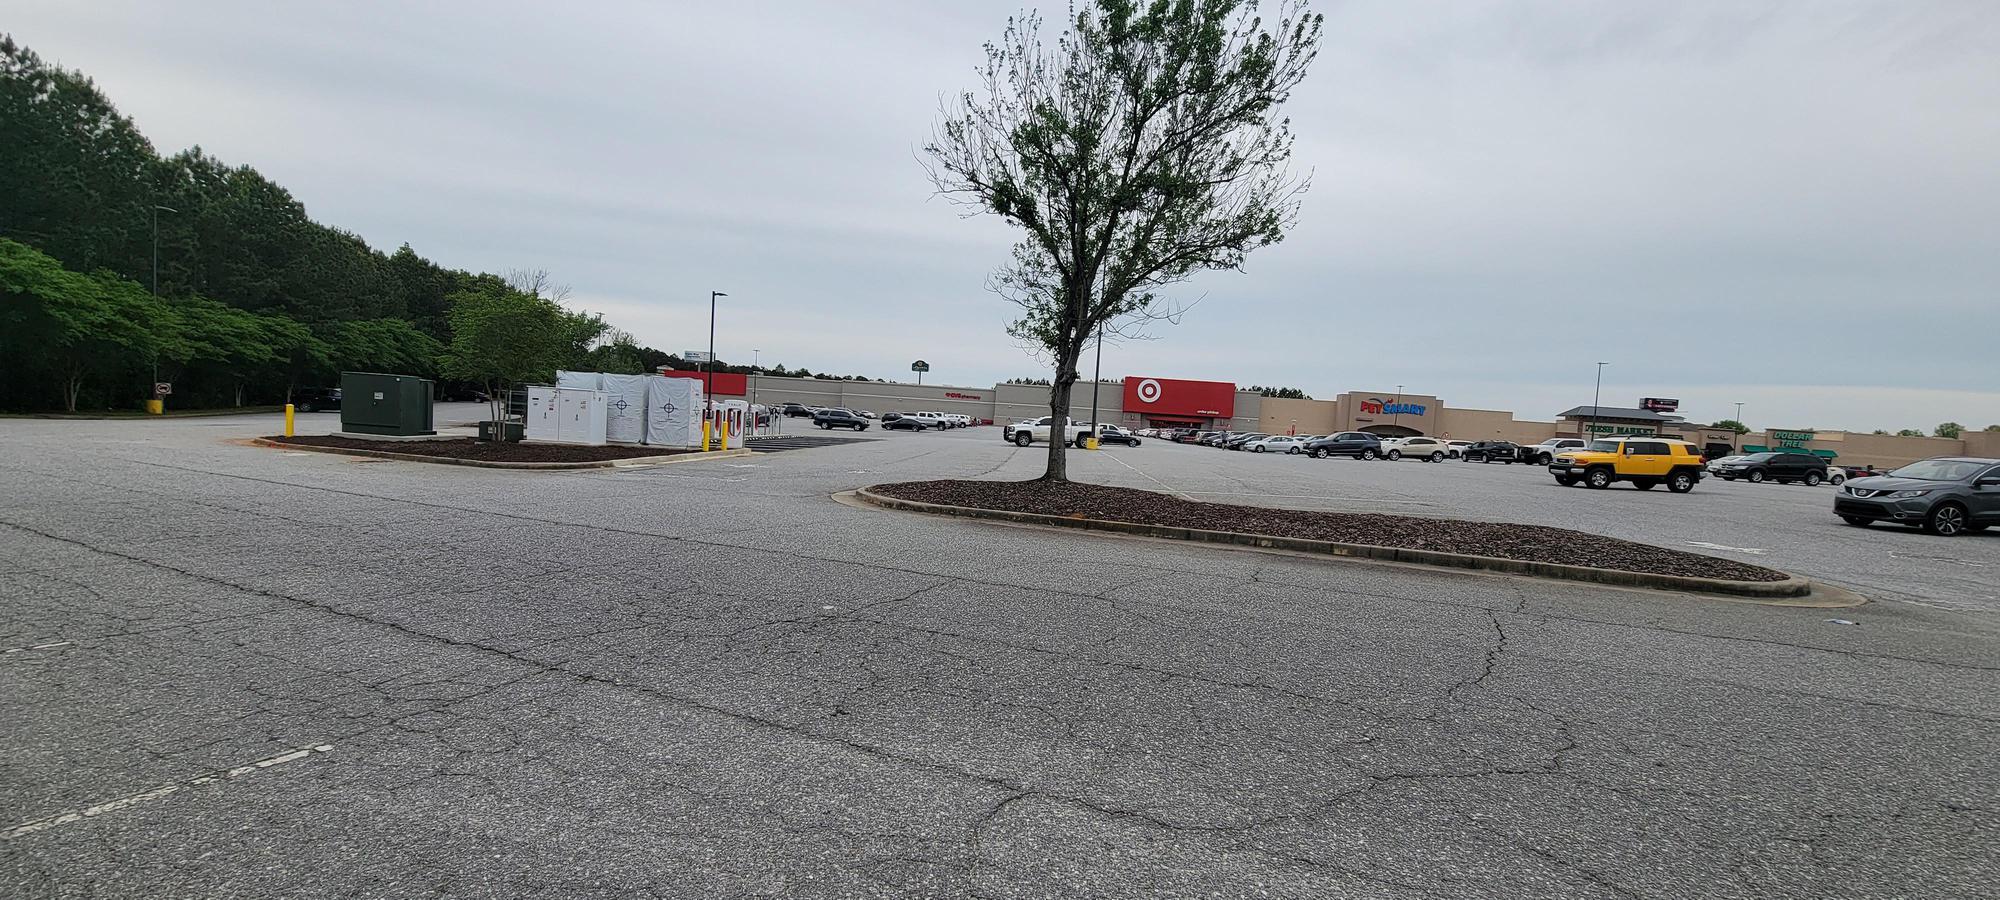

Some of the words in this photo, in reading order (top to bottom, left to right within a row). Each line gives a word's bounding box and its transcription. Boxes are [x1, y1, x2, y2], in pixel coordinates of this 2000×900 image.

[1360, 400, 1426, 416] PETSMART
[1585, 424, 1614, 433] FRESH
[1617, 426, 1656, 435] MARKET
[1774, 431, 1813, 441] DOLLAR
[1781, 439, 1805, 448] TREE
